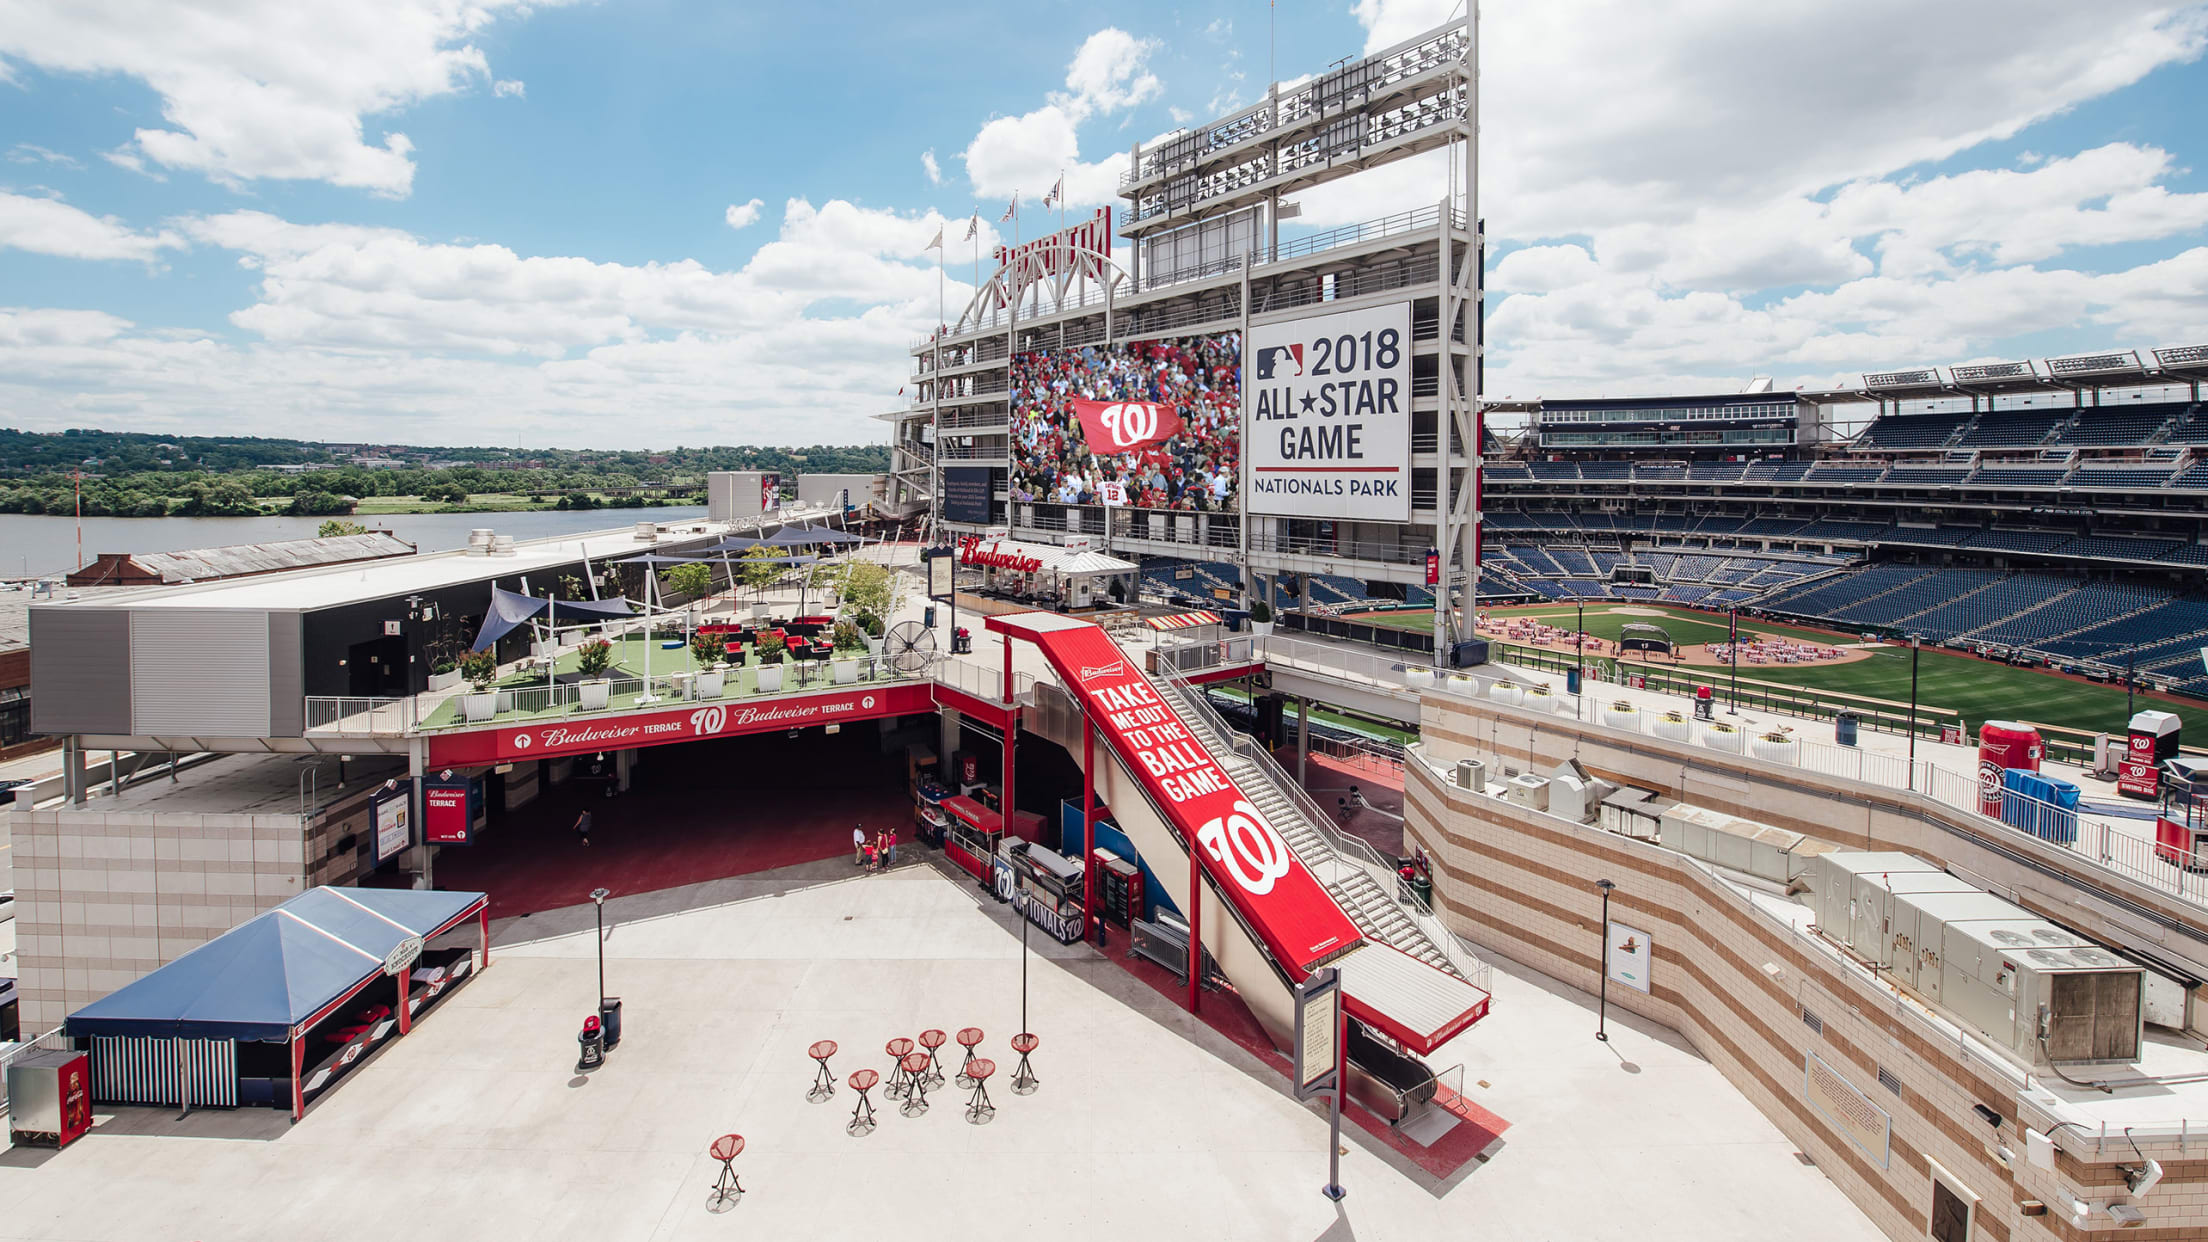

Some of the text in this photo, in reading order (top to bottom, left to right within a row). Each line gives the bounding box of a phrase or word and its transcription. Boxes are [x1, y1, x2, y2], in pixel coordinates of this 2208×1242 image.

[1312, 328, 1400, 376] 2018
[1256, 378, 1399, 421] ALL STAR
[1281, 424, 1363, 459] GAME
[1107, 489, 1119, 501] 12
[1255, 479, 1398, 496] NATIONALS PARK
[958, 536, 1043, 573] Budweiser
[1084, 665, 1122, 678] Budweiser
[1091, 682, 1158, 711] TAKE
[541, 724, 639, 747] Budweiser
[644, 721, 682, 734] TERRACE
[734, 705, 818, 725] Budweiser
[821, 702, 854, 714] TERRACE
[1109, 705, 1169, 731] ME OUT
[1123, 722, 1187, 749] TO THE
[1138, 741, 1209, 777] BALL
[428, 790, 465, 798] Budweiser
[1161, 767, 1230, 802] GAME
[2121, 783, 2142, 791] SWING
